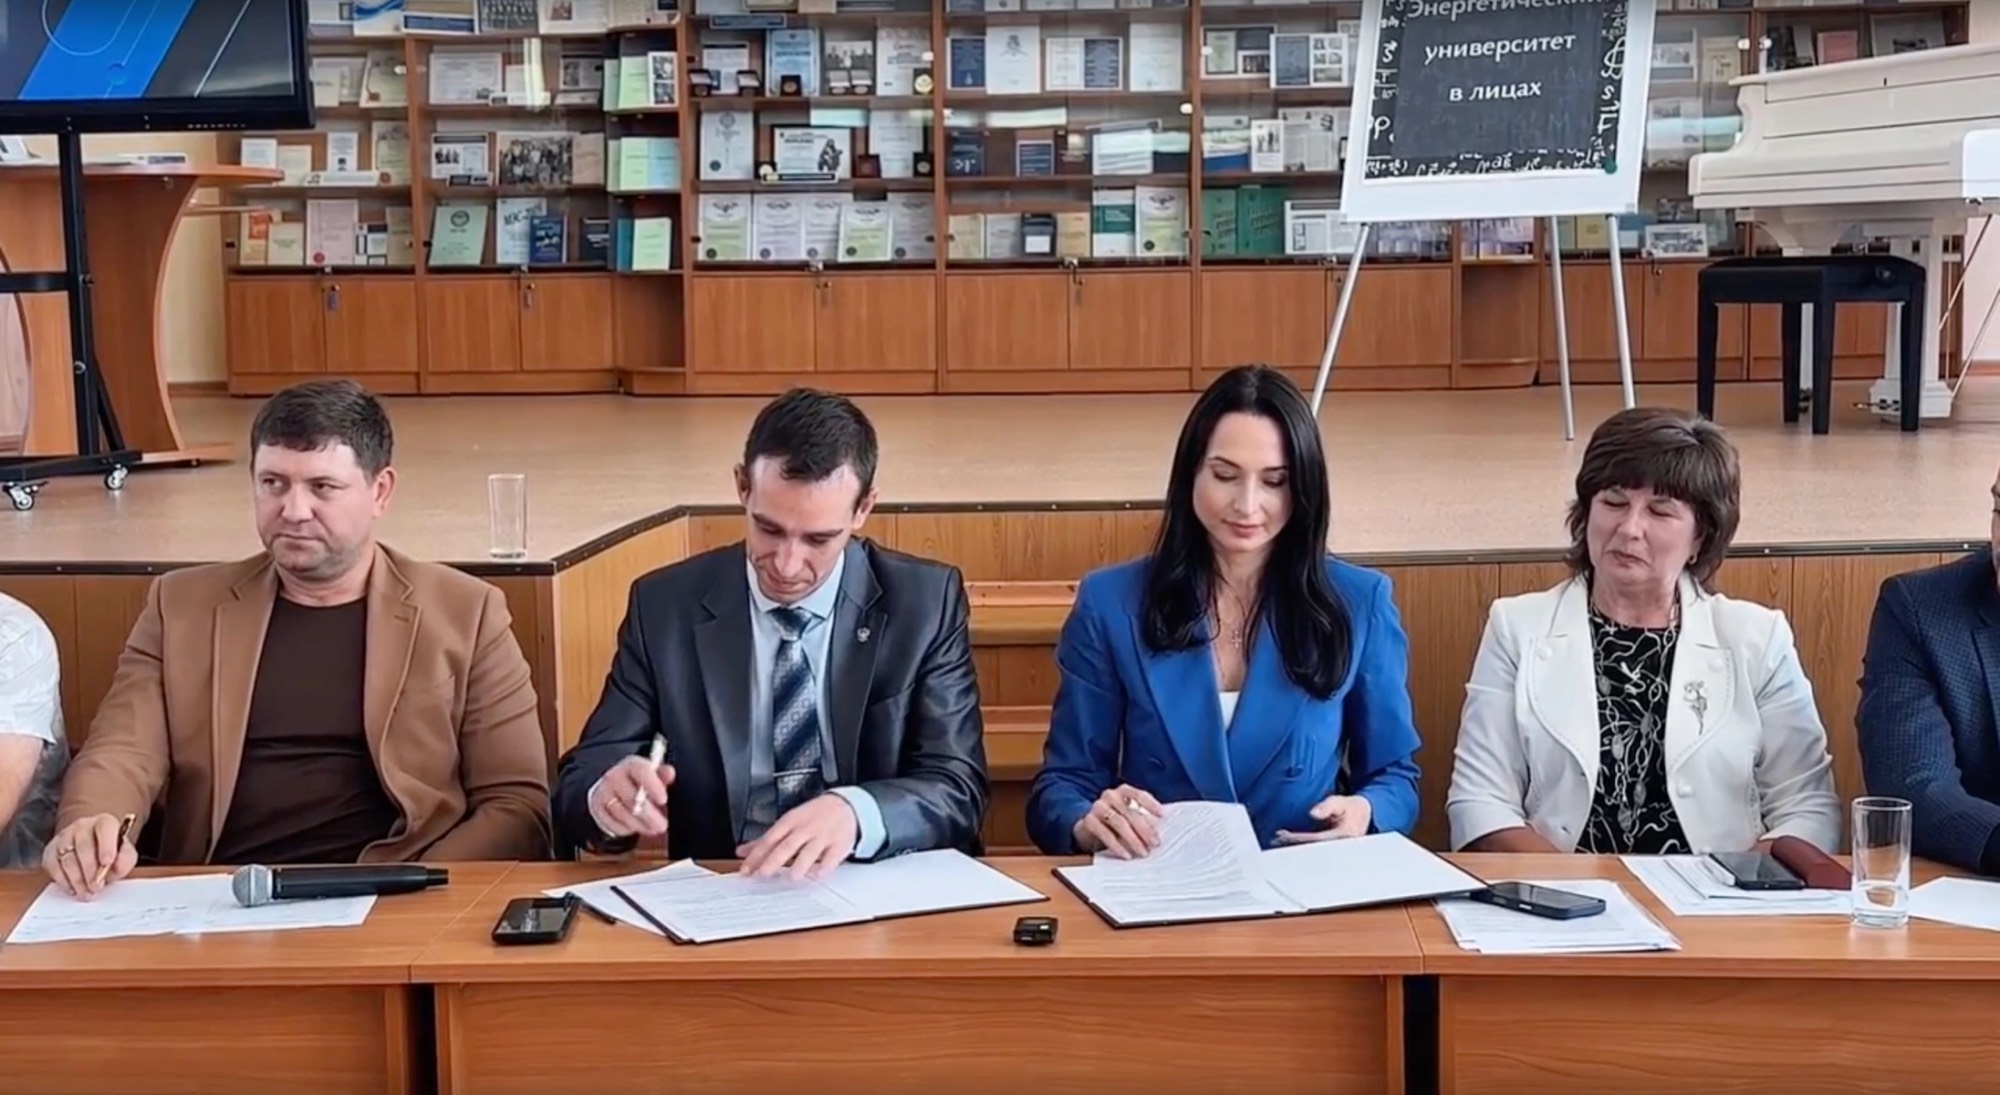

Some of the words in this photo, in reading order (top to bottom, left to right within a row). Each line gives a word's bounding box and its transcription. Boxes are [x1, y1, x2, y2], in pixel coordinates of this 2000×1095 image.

[1407, 0, 1605, 21] Энергетичес
[1424, 35, 1576, 65] университет
[1449, 87, 1463, 101] в
[1469, 81, 1542, 100] лицах
